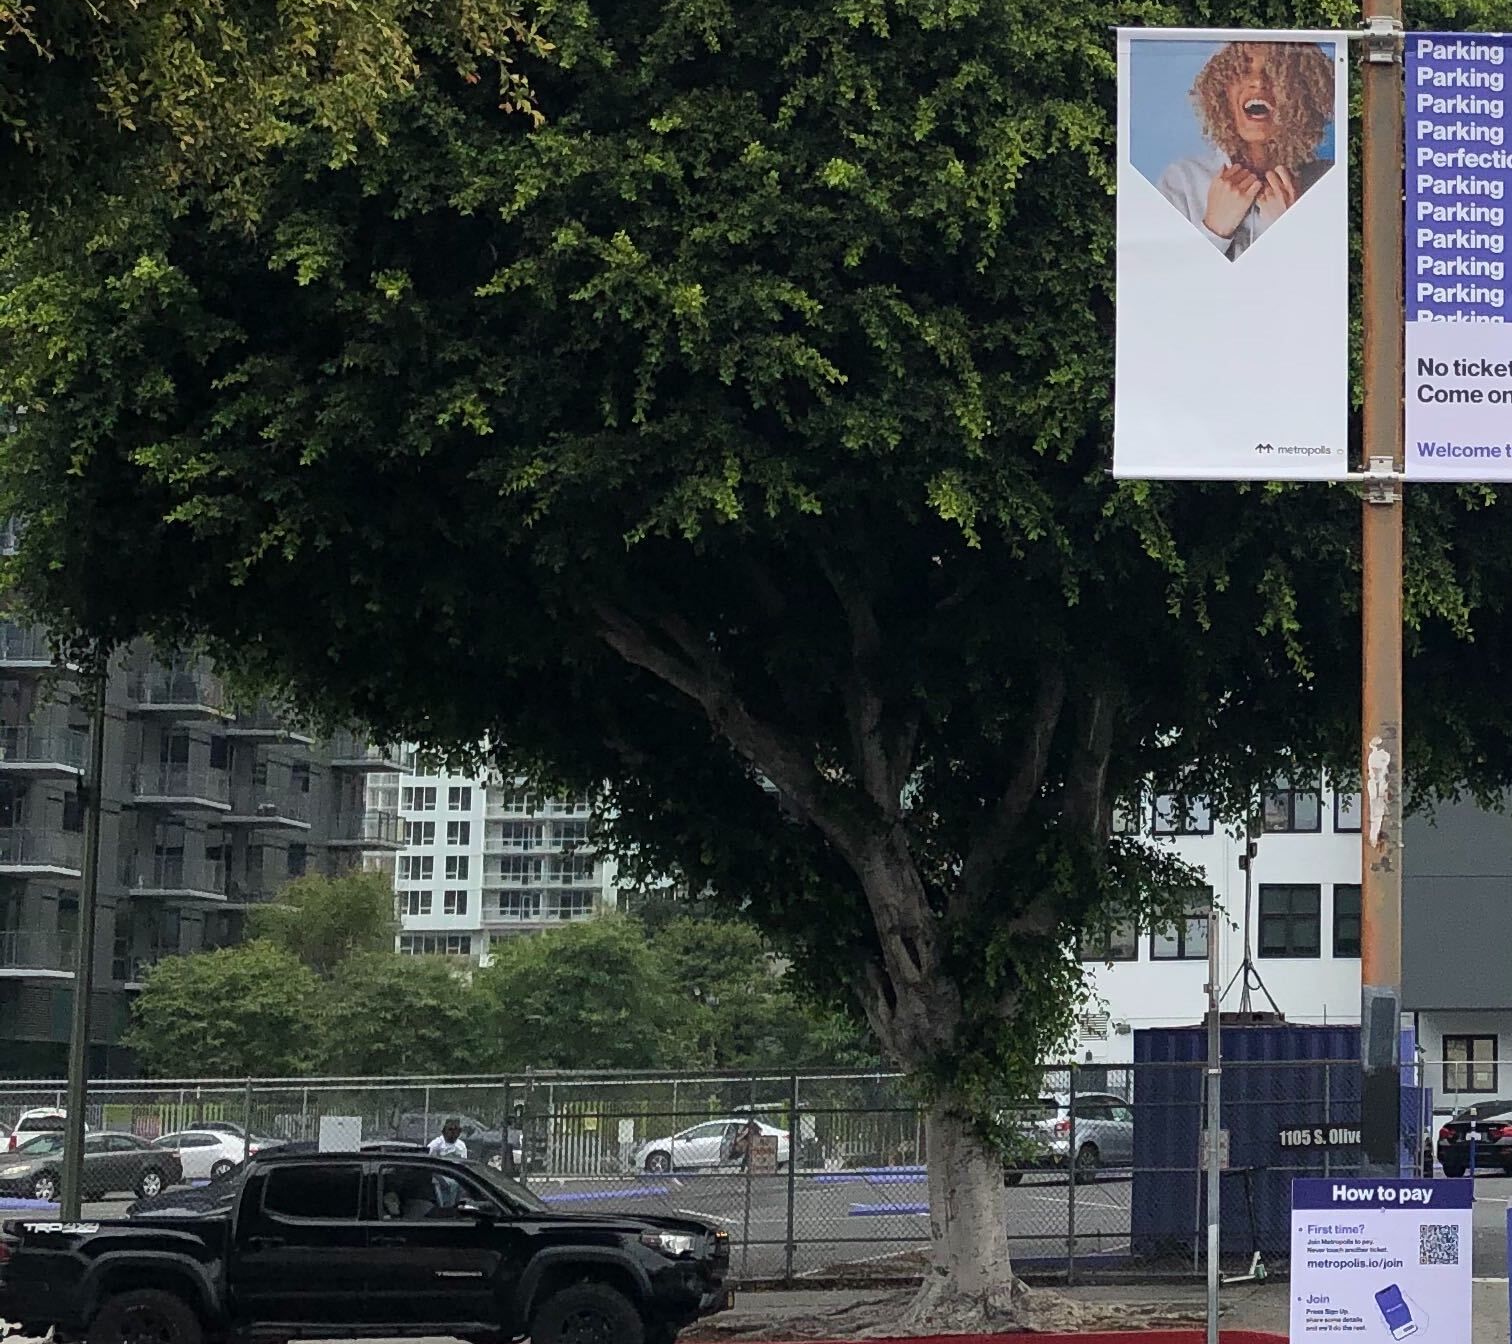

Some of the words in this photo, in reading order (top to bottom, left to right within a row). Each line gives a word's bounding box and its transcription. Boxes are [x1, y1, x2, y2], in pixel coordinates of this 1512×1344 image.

[1417, 40, 1504, 65] Parking
[1417, 67, 1504, 92] Parking
[1417, 94, 1504, 119] Parking
[1417, 121, 1504, 146] Parking
[1417, 175, 1504, 200] Parking
[1417, 202, 1504, 227] Parking
[1417, 229, 1504, 254] Parking
[1417, 256, 1504, 281] Parking
[1417, 283, 1504, 308] Parking
[1417, 358, 1449, 377] No
[1417, 385, 1483, 405] Come
[1277, 445, 1331, 457] metropolis
[1416, 442, 1502, 458] Welcome
[1279, 1129, 1311, 1146] 1105
[1313, 1129, 1327, 1145] S.
[1332, 1185, 1375, 1203] How
[1377, 1185, 1396, 1203] to
[1399, 1187, 1433, 1204] pay
[1307, 1224, 1332, 1234] First
[1335, 1224, 1365, 1234] time?
[1307, 1258, 1403, 1270] metropolis.io/join
[1306, 1294, 1330, 1304] Join
